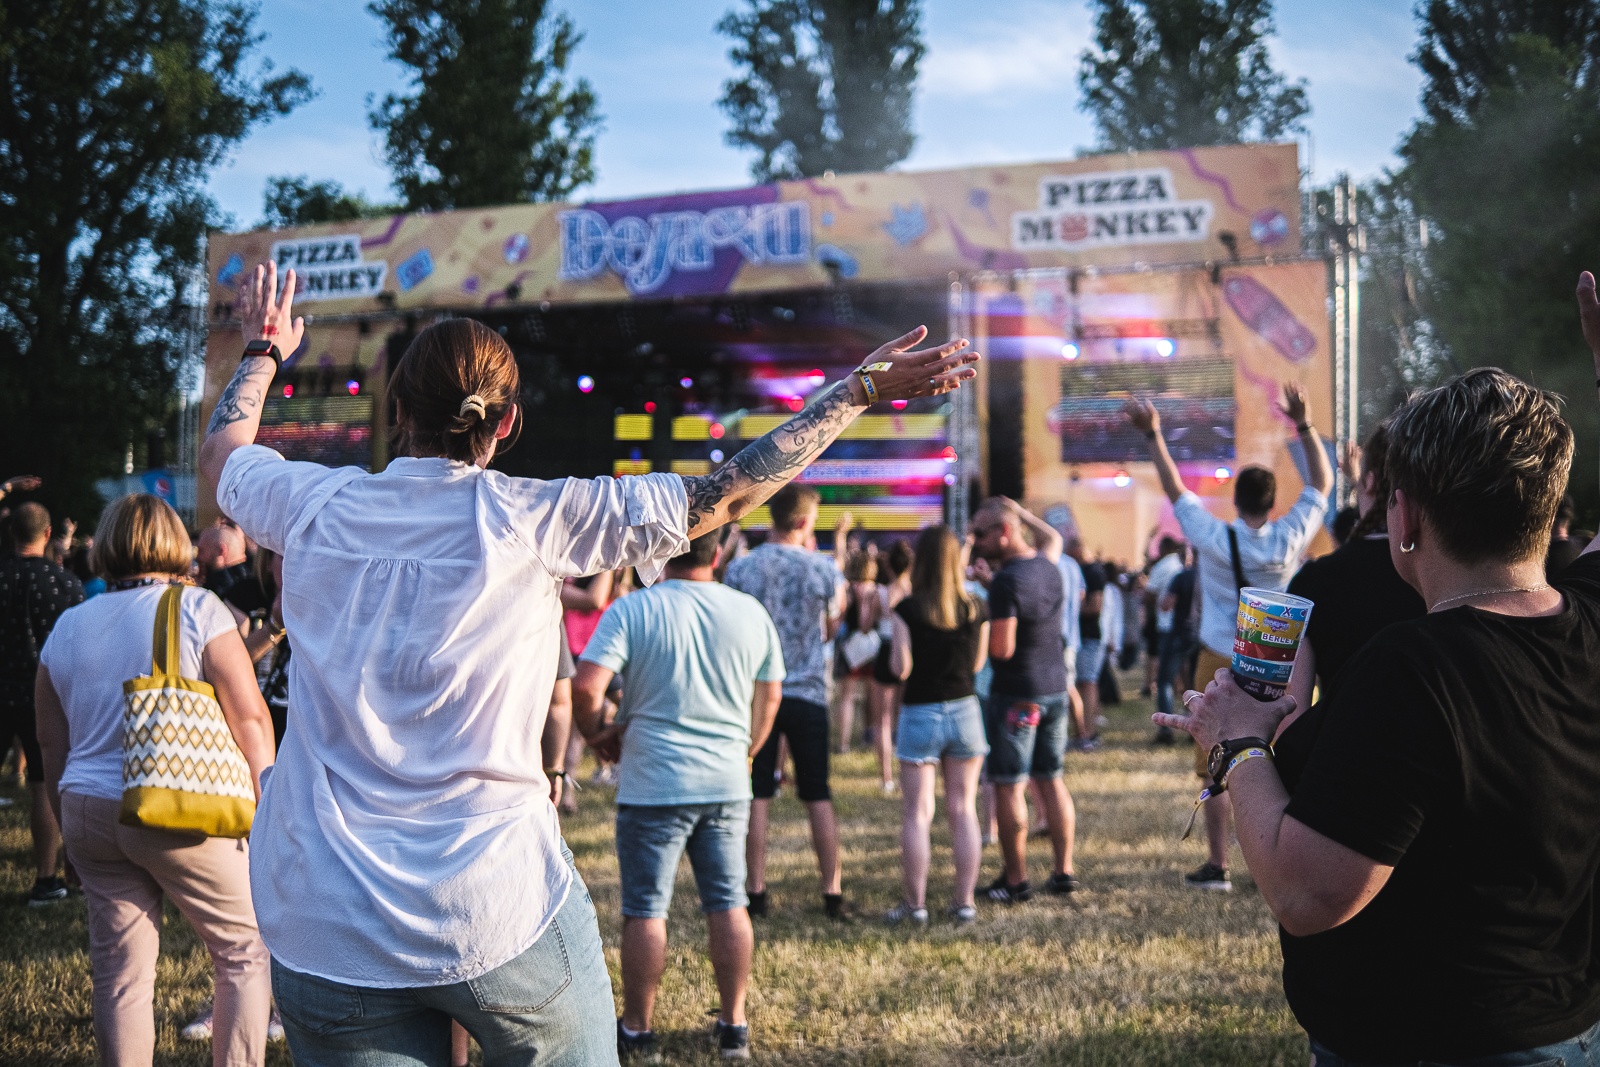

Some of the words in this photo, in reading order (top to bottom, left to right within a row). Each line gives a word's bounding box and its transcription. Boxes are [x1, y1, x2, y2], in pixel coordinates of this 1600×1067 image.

[1046, 174, 1169, 207] PIZZA
[278, 242, 357, 267] PIZZA
[276, 267, 384, 292] NKEY
